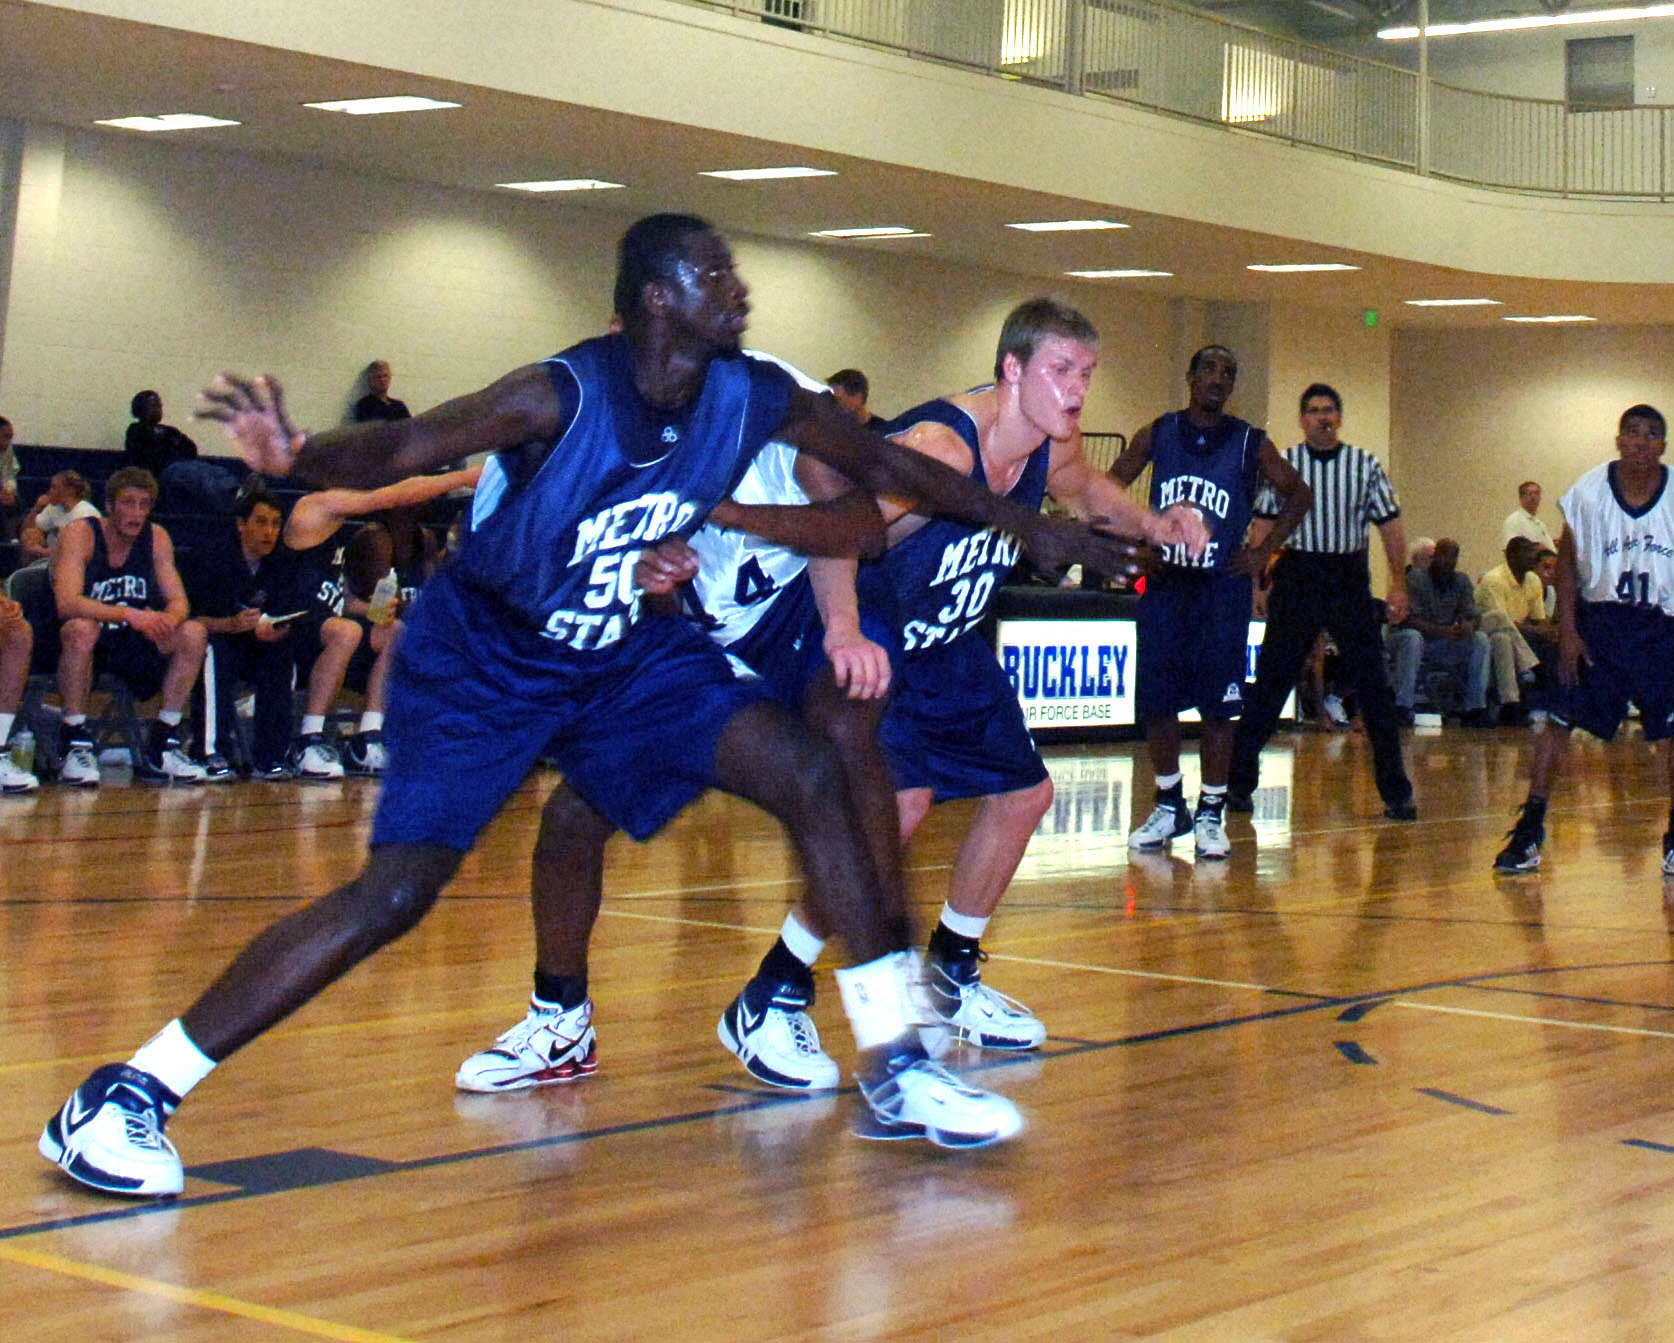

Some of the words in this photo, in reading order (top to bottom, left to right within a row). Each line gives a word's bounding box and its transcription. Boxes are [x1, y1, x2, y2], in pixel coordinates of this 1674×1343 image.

[1160, 475, 1230, 519] METRO
[567, 491, 697, 568] METRO
[90, 574, 147, 602] METRO
[938, 571, 995, 625] 30
[1616, 570, 1652, 607] 41
[1003, 644, 1128, 699] BUCKLEY
[1025, 705, 1037, 721] IR
[1040, 704, 1079, 721] FORCE
[1082, 703, 1111, 719] BASE
